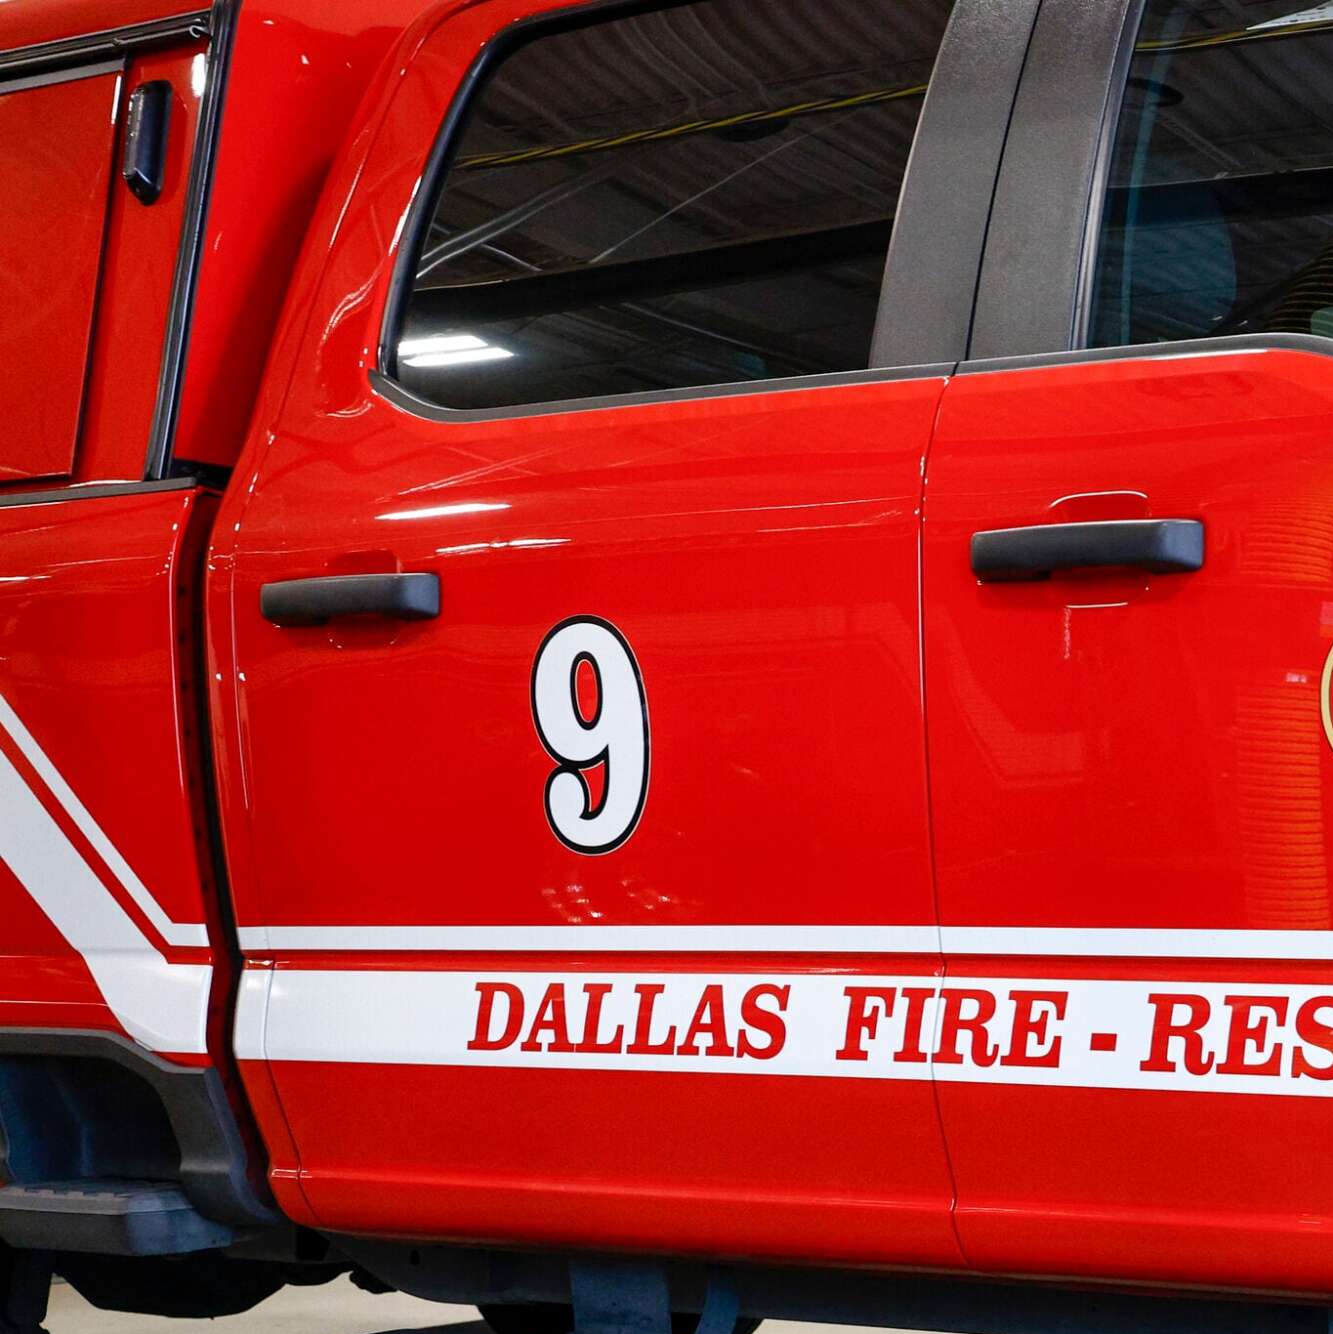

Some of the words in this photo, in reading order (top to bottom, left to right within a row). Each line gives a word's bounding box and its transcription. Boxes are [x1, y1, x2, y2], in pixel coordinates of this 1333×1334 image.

[529, 614, 651, 856] 9
[467, 982, 792, 1060] DALLAS
[836, 986, 1068, 1067] FIRE
